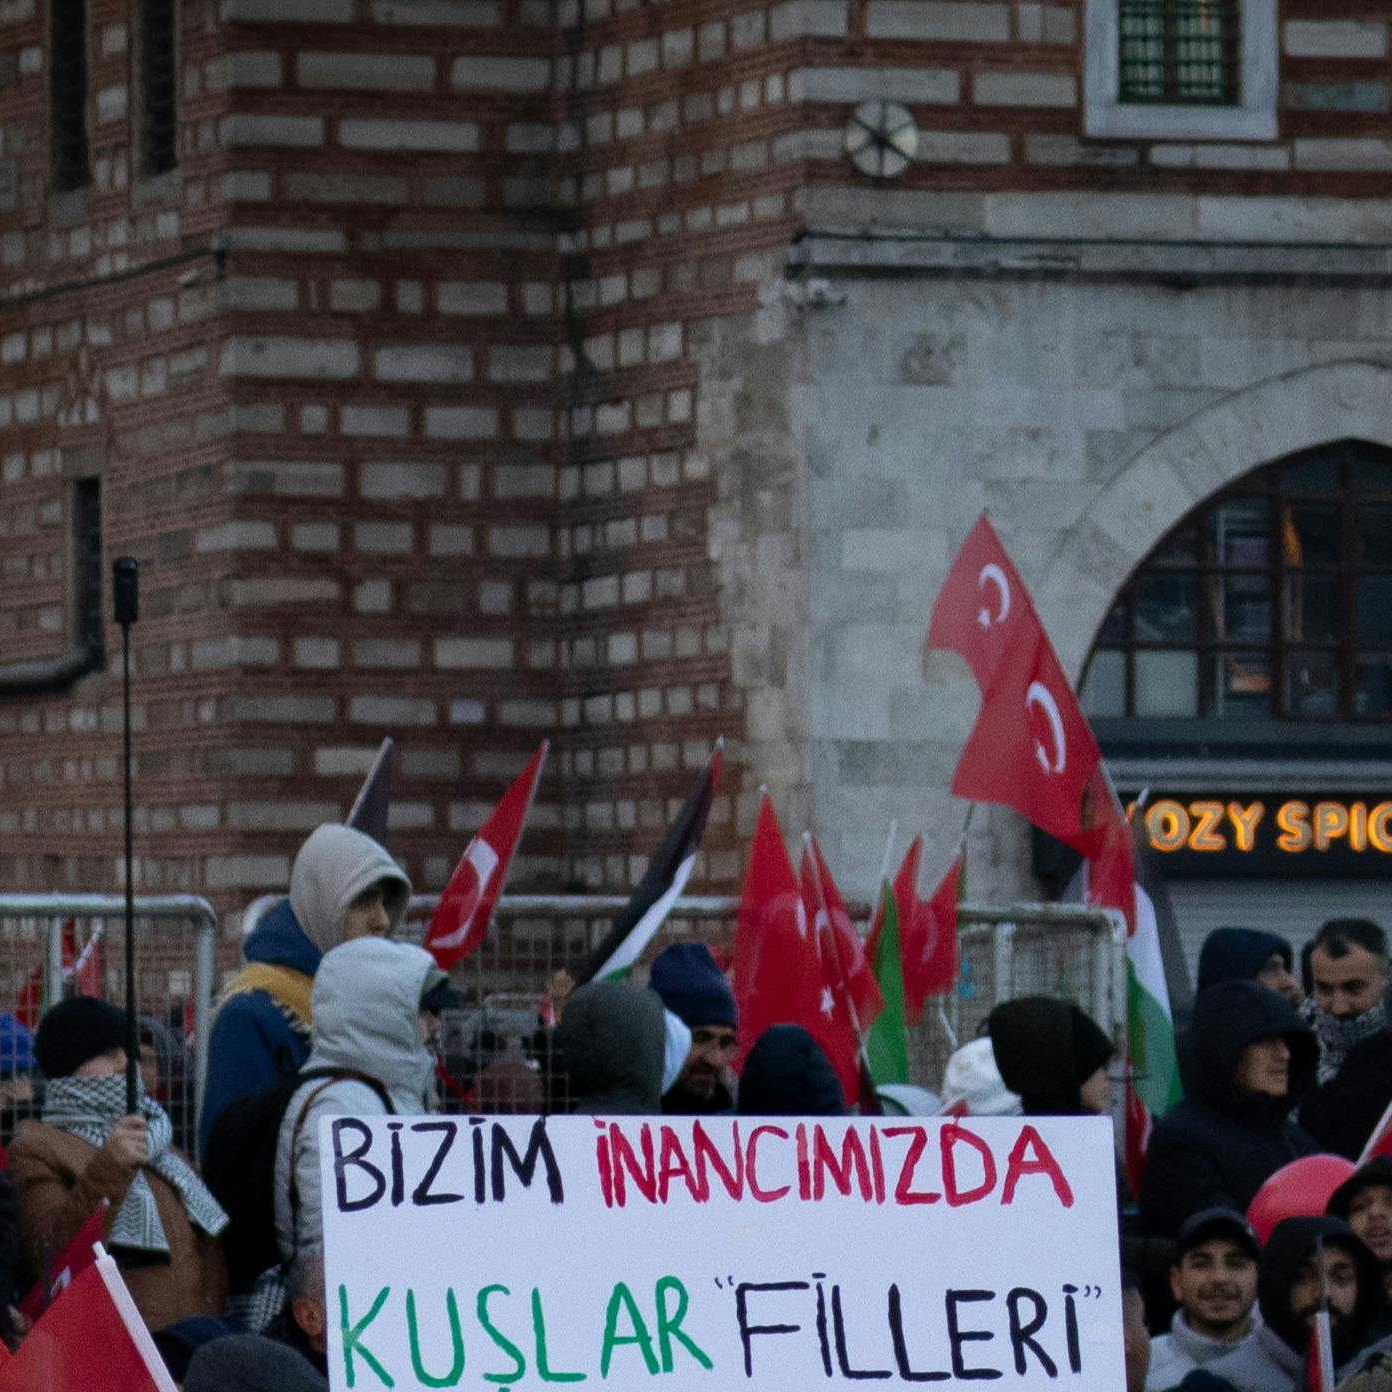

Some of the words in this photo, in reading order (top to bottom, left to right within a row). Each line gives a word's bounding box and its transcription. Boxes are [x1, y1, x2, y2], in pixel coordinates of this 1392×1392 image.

[1126, 798, 1266, 853] OZY
[332, 1116, 564, 1212] BİZİM
[592, 1115, 1075, 1209] İNANCIMIZDA
